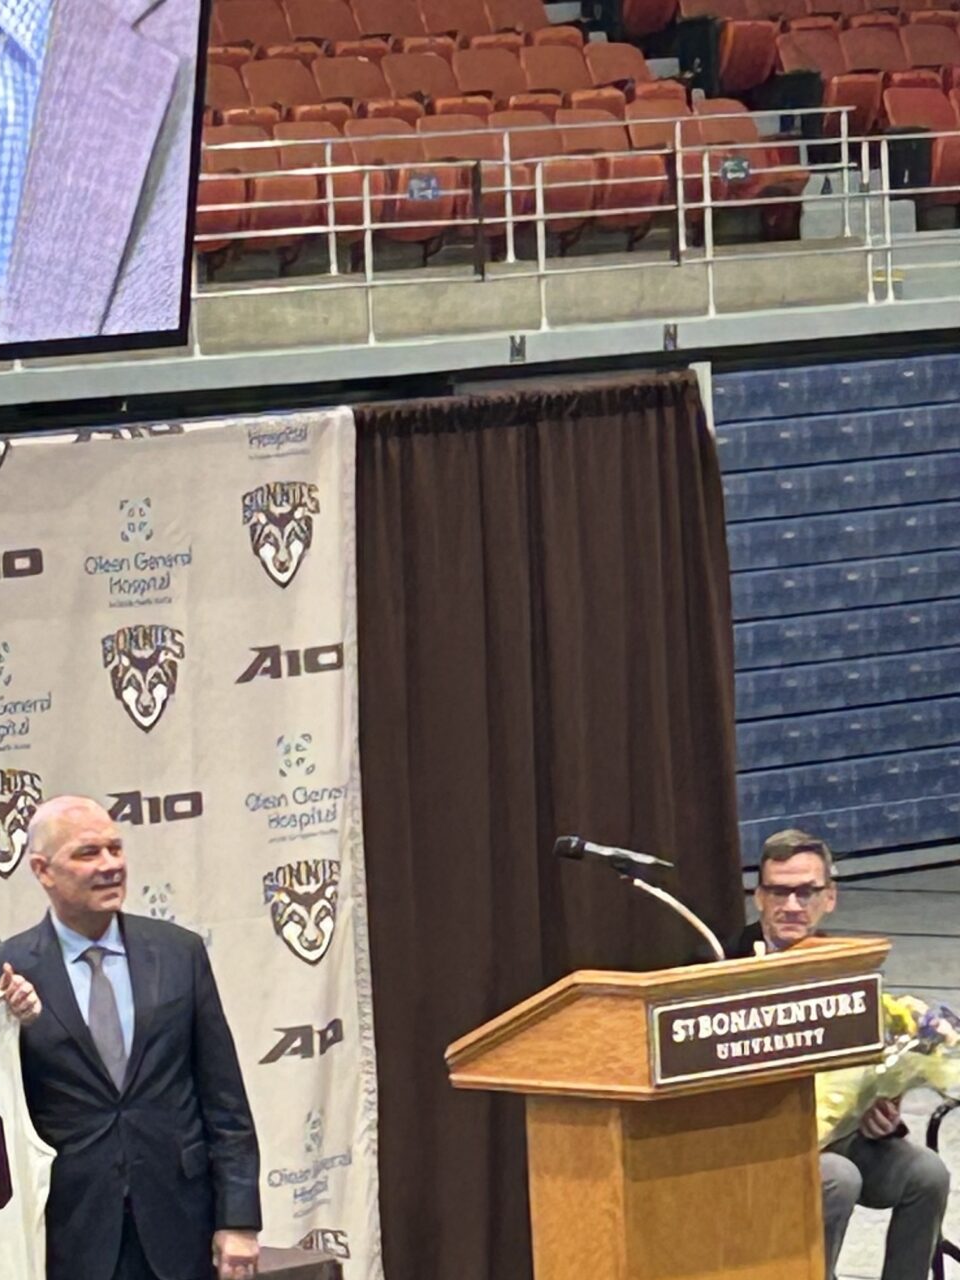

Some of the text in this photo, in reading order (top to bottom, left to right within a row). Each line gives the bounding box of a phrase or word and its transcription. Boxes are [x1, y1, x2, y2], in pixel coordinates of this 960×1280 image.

[242, 481, 321, 525] BONNIES
[101, 624, 185, 669] BONNIES
[234, 642, 344, 684] A10
[106, 790, 203, 826] A10
[263, 858, 341, 905] BONNIE
[697, 991, 867, 1039] BONAVENTURE
[716, 1028, 825, 1059] UNIVERSITY
